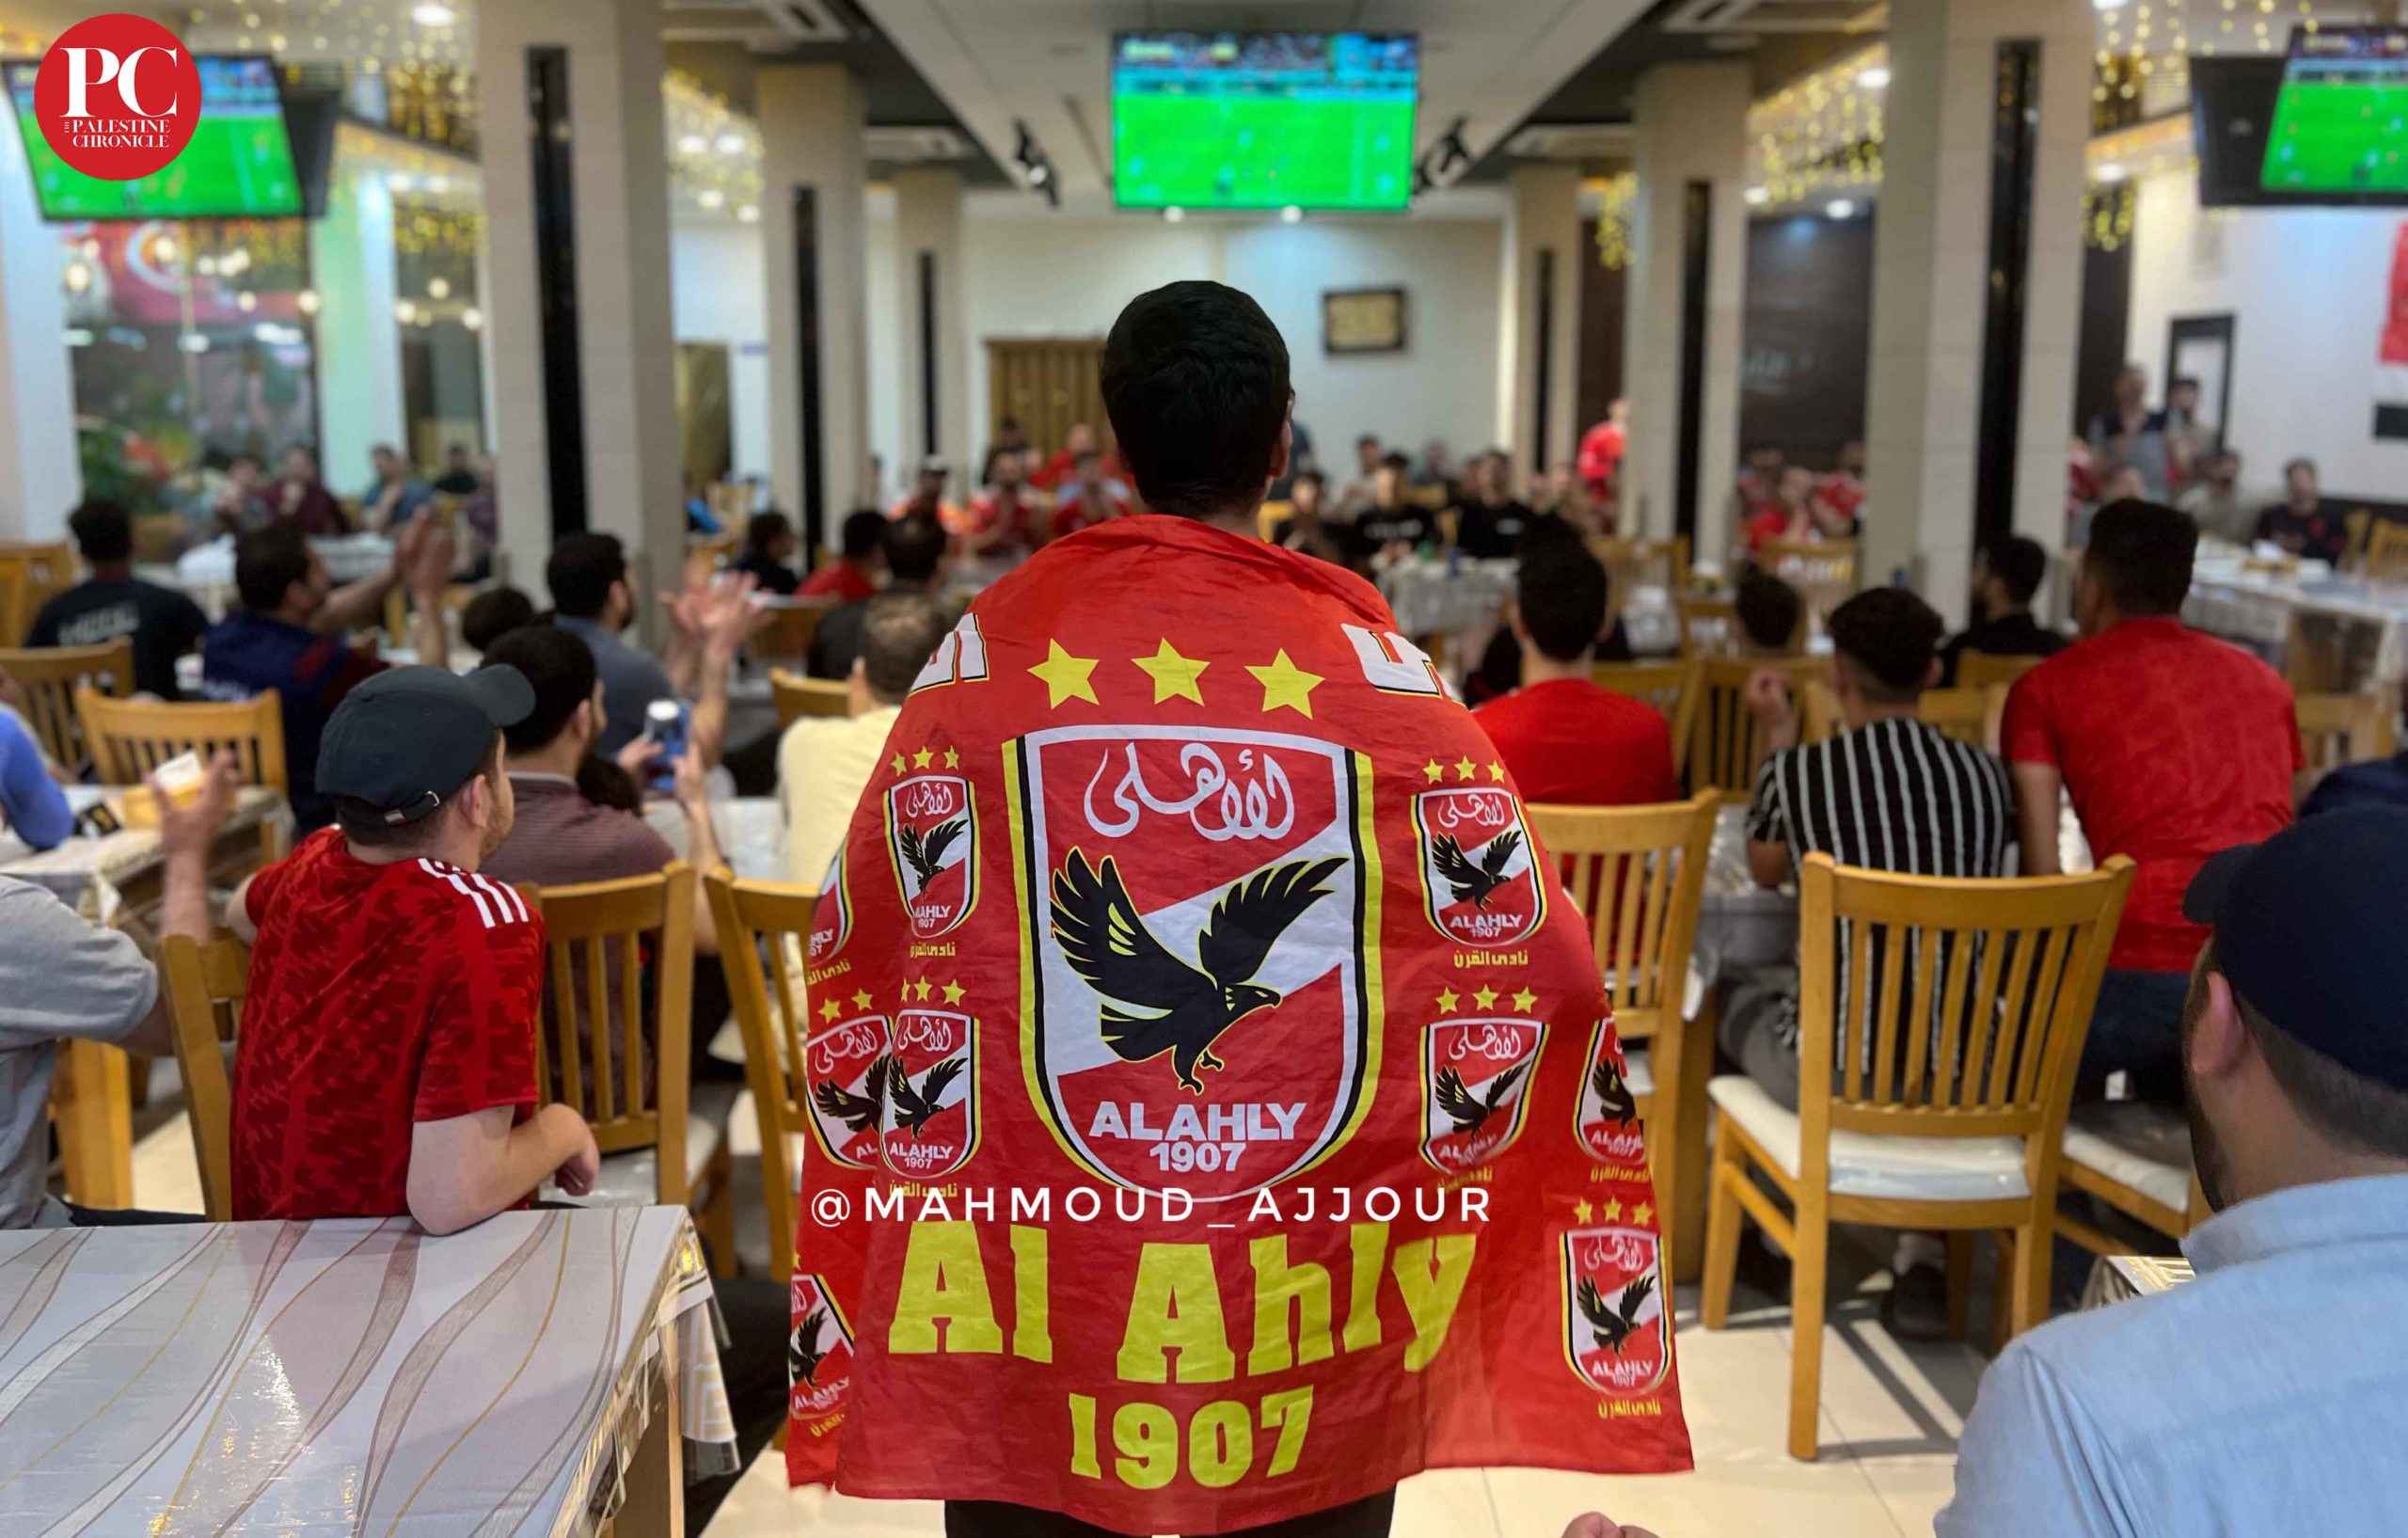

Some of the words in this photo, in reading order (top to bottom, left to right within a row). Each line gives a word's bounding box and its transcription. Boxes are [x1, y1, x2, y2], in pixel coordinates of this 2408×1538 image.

[1450, 913, 1523, 928] ALAHLY
[1088, 1100, 1307, 1141] ALAHLY
[890, 1141, 954, 1160] ALAHLY
[904, 1157, 933, 1169] 1907
[1149, 1141, 1247, 1173] 1907
[889, 1220, 1052, 1363] Al
[1117, 1221, 1477, 1384] Ahly
[1069, 1385, 1314, 1490] 1907
